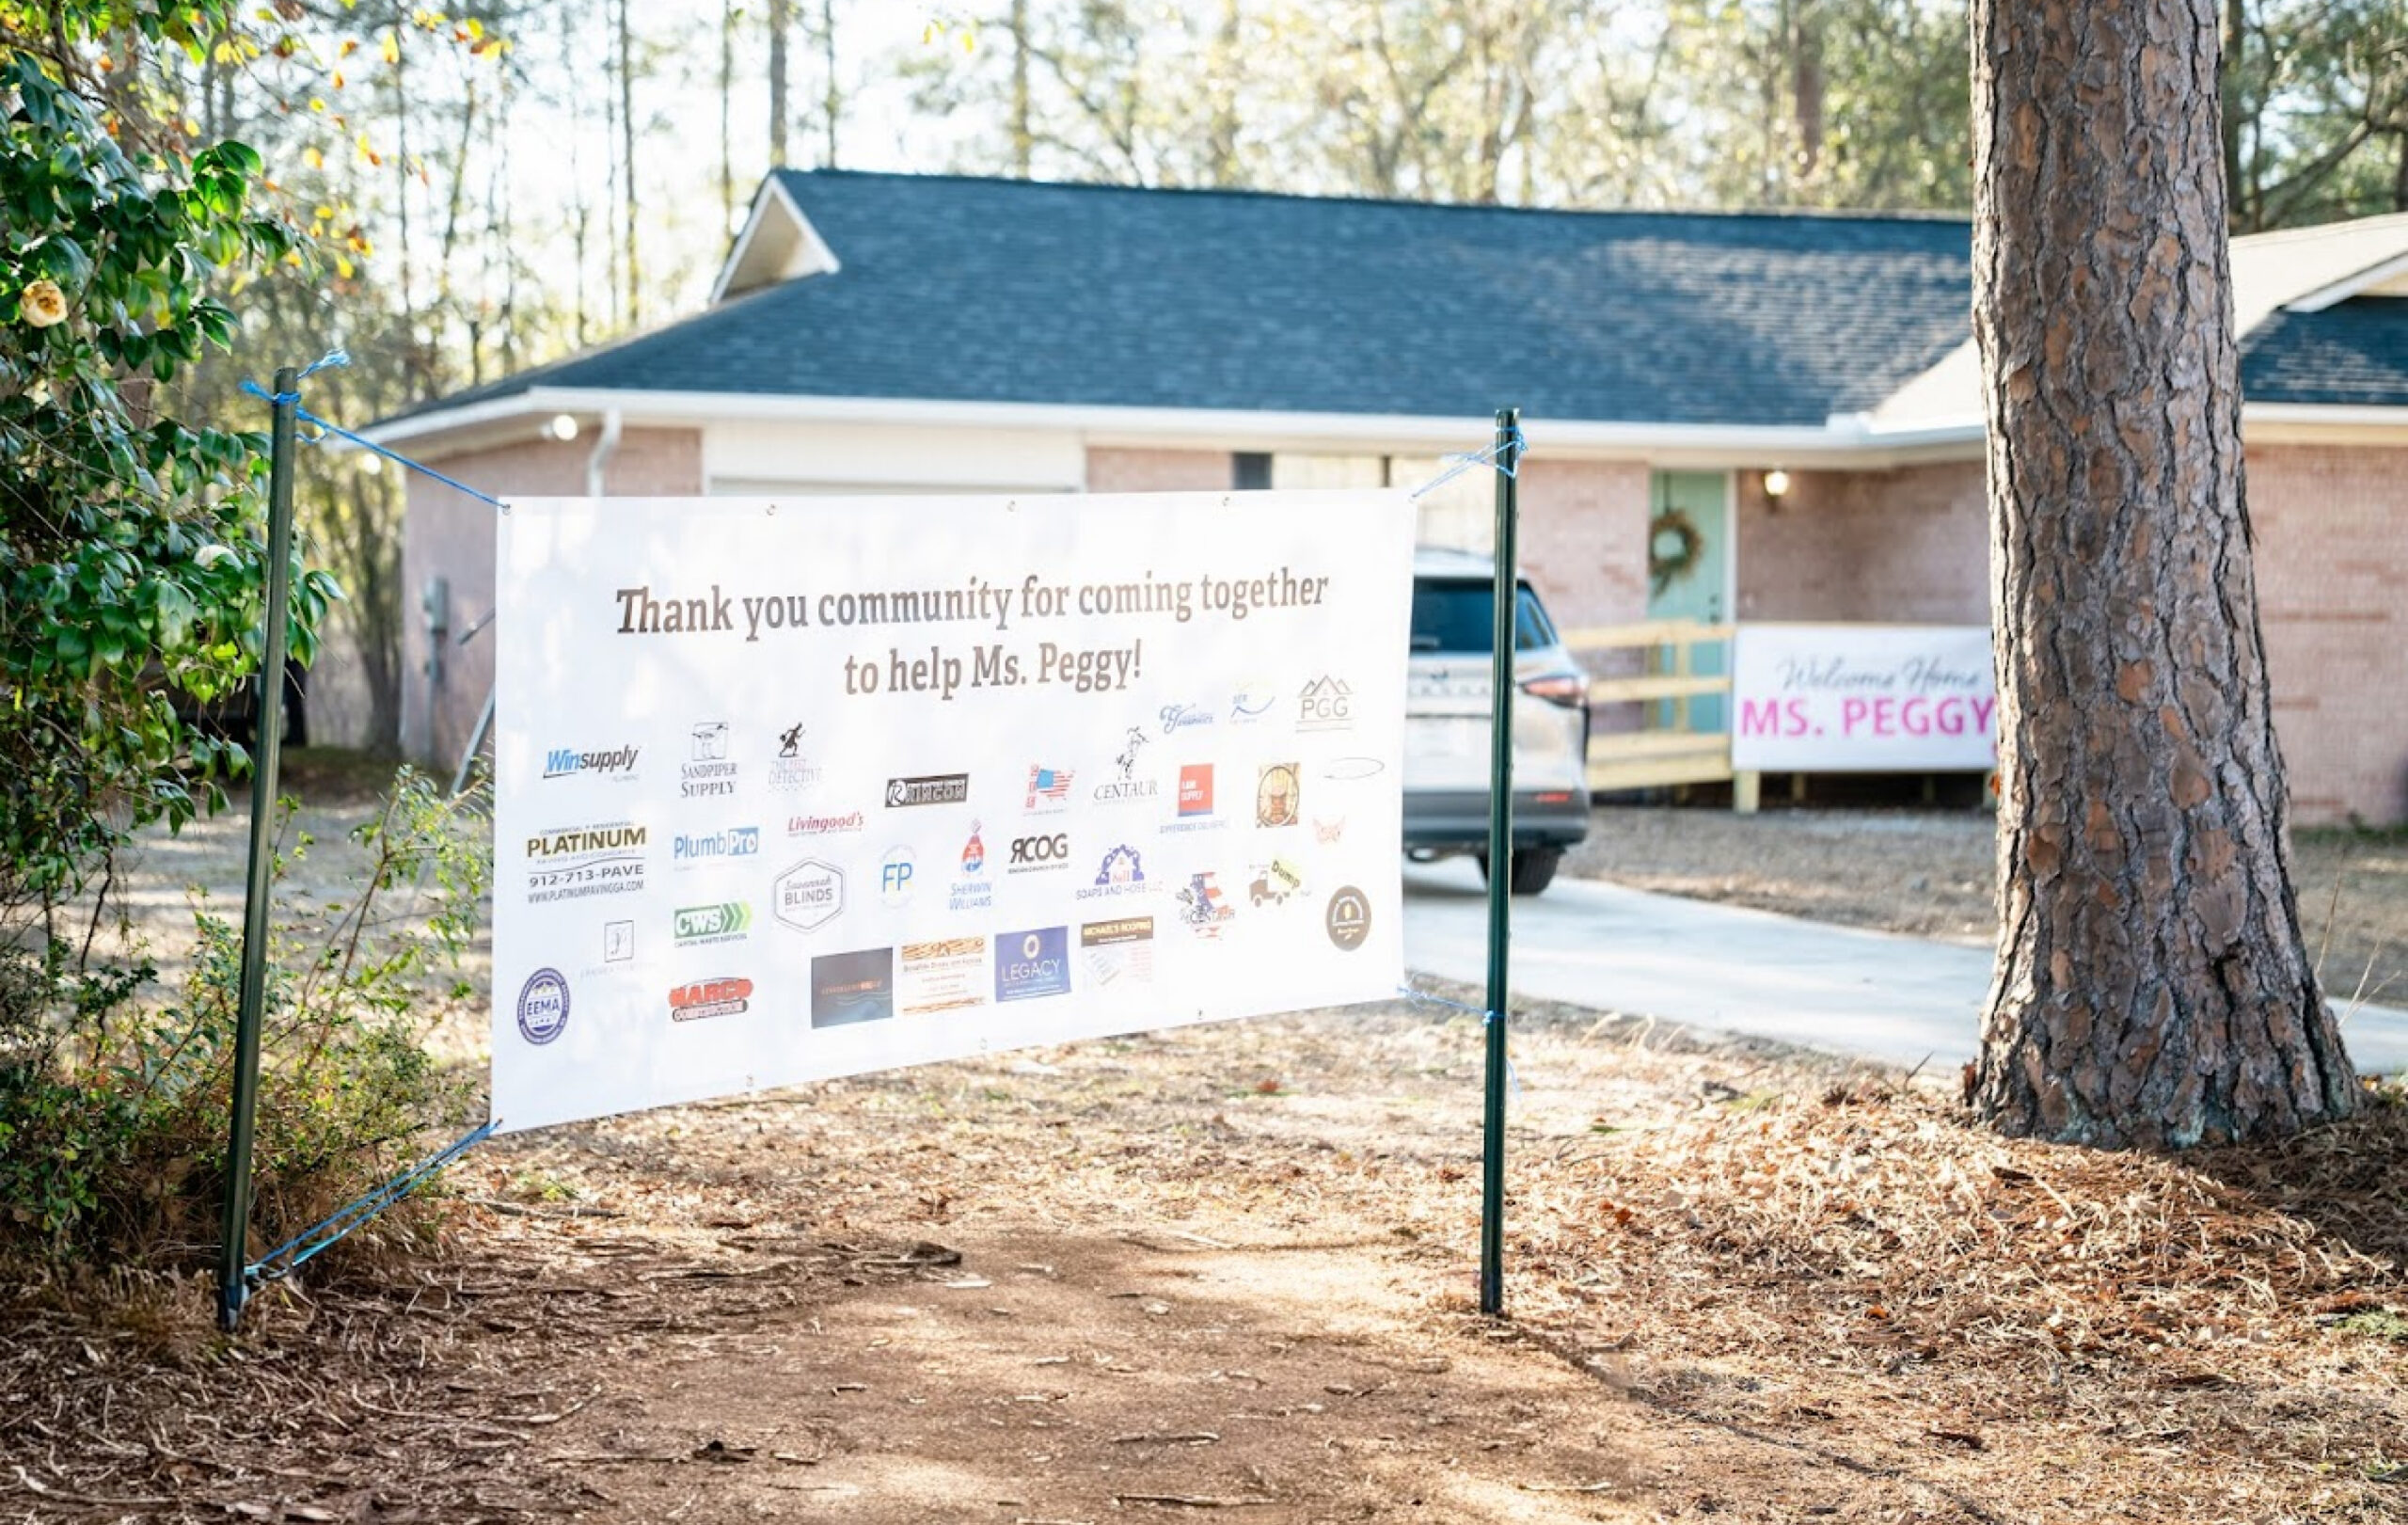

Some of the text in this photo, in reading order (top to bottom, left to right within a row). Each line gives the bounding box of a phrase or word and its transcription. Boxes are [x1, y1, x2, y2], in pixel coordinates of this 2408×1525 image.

[616, 566, 1330, 642] Thank you community for coming together
[845, 639, 1143, 701] to help Ms. Peggy!
[1776, 657, 1895, 691] Welcome
[1300, 696, 1349, 721] PGG
[1742, 696, 1995, 737] MS. PEGGY
[547, 743, 639, 774] Winsupply
[681, 762, 738, 781] SANDPIPER
[680, 780, 737, 799] SUPPLY
[1093, 781, 1158, 801] CENTAUR
[788, 811, 863, 833] Livingood's
[527, 826, 646, 857] PLATINUM
[673, 827, 759, 860] PlumbPro
[529, 865, 644, 887] 912-713-PAVE
[882, 862, 913, 893] FP
[1271, 860, 1301, 890] Dump
[784, 888, 833, 906] BLINDS
[951, 882, 991, 897] SHERWIN
[1103, 884, 1122, 896] AND
[949, 895, 991, 912] WILLIAMS
[675, 910, 721, 935] CWS
[1001, 959, 1060, 981] LEGACY
[527, 997, 560, 1016] EEMA
